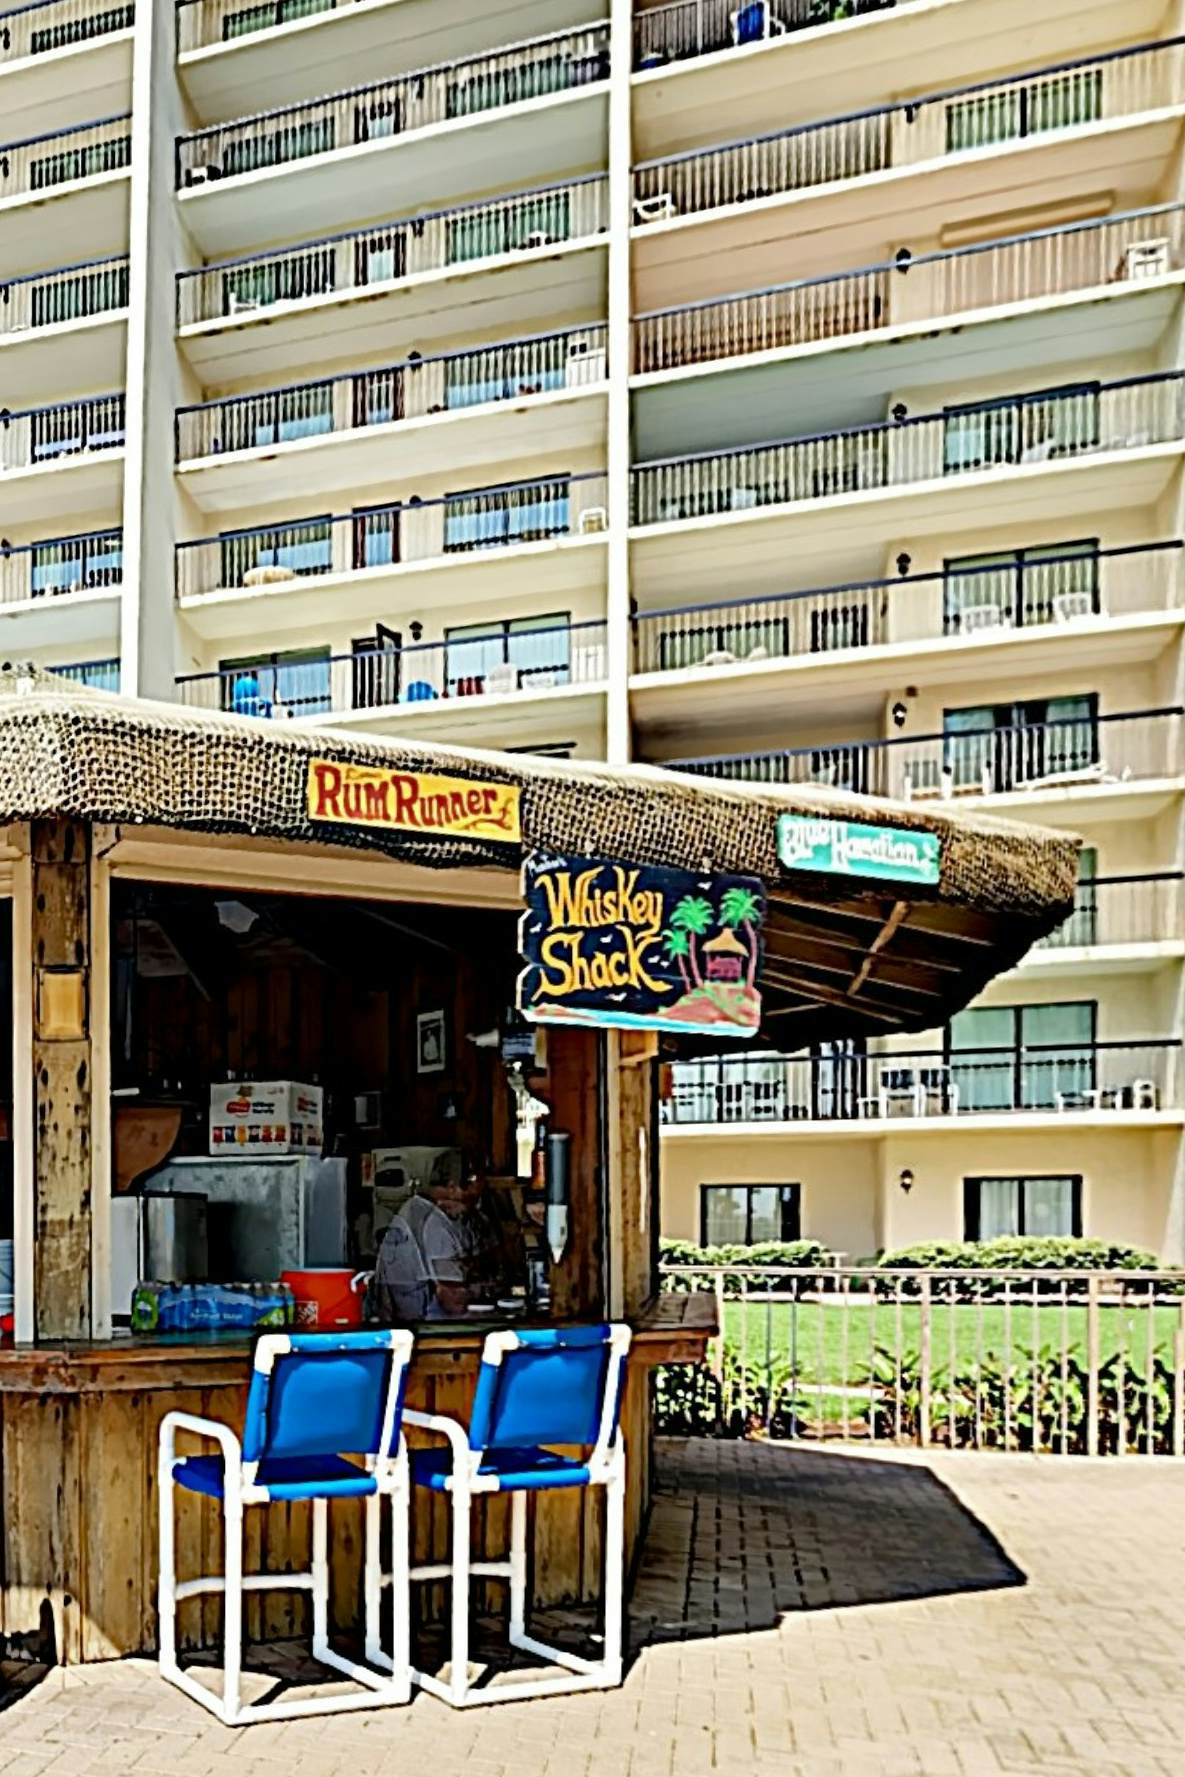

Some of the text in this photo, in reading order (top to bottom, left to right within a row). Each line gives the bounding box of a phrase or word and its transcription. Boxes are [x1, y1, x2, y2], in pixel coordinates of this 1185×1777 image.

[314, 763, 499, 828] Rum Runner
[782, 822, 831, 866] Blue
